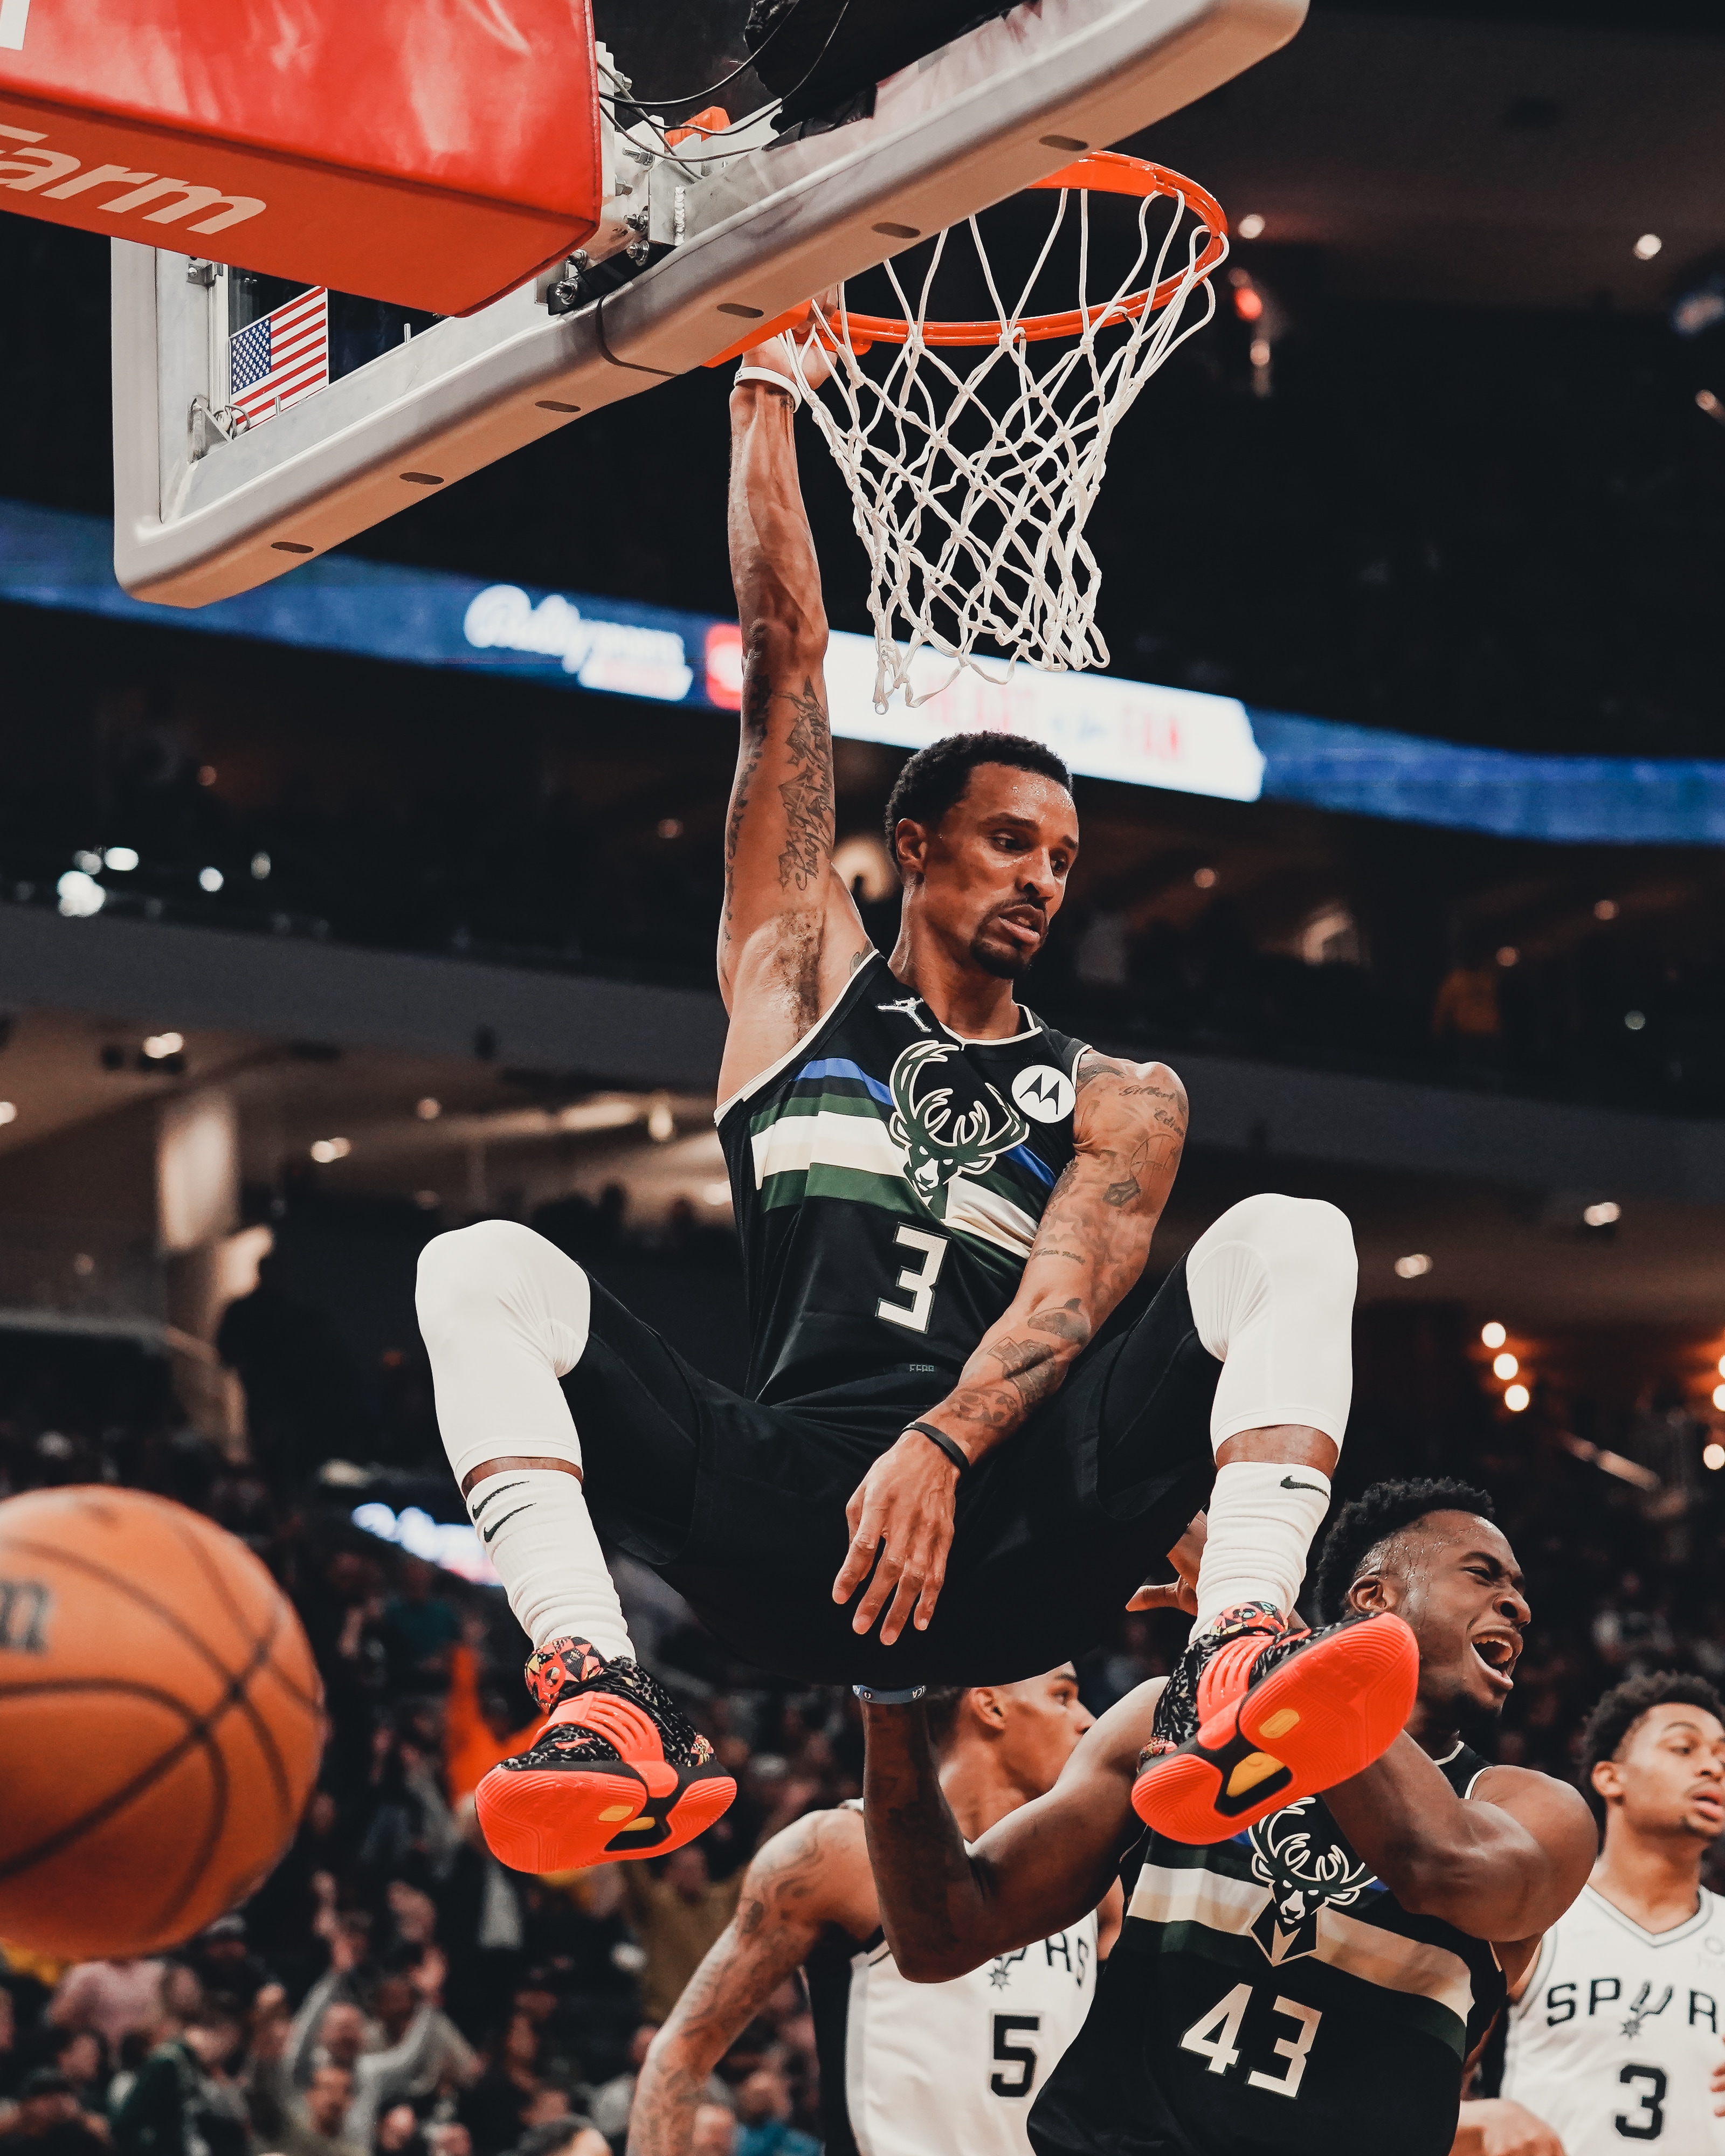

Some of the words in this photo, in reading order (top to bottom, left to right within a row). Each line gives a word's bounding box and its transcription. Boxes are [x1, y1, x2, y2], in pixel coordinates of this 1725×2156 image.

[875, 1222, 951, 1334] 3
[989, 2012, 1041, 2099] 5
[1179, 1982, 1323, 2099] 43
[1615, 2063, 1668, 2140] 3
